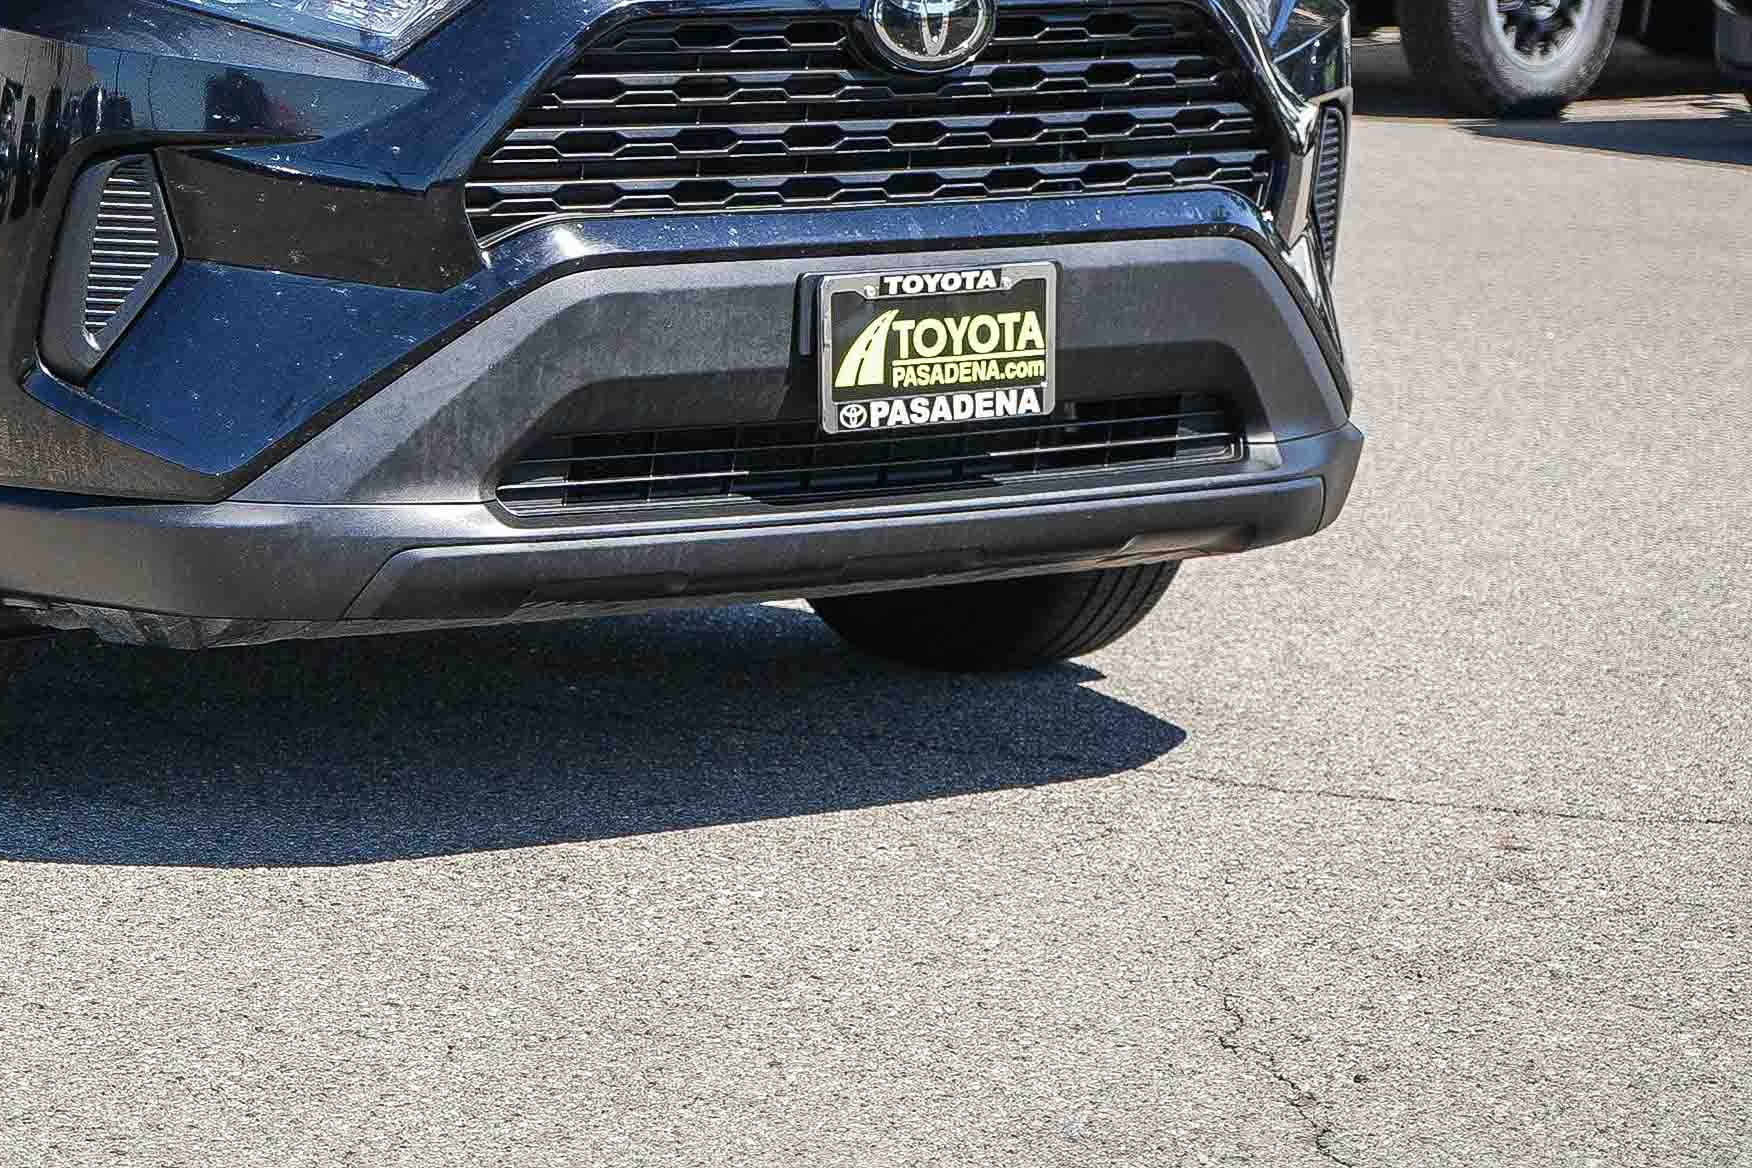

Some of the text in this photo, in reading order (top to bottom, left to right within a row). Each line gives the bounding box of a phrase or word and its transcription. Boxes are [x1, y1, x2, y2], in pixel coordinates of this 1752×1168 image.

[883, 270, 997, 295] TOYOTA
[892, 311, 1045, 359] TOYOTA
[892, 359, 1045, 388] PASADENA.com
[870, 389, 1040, 427] PASADENA
